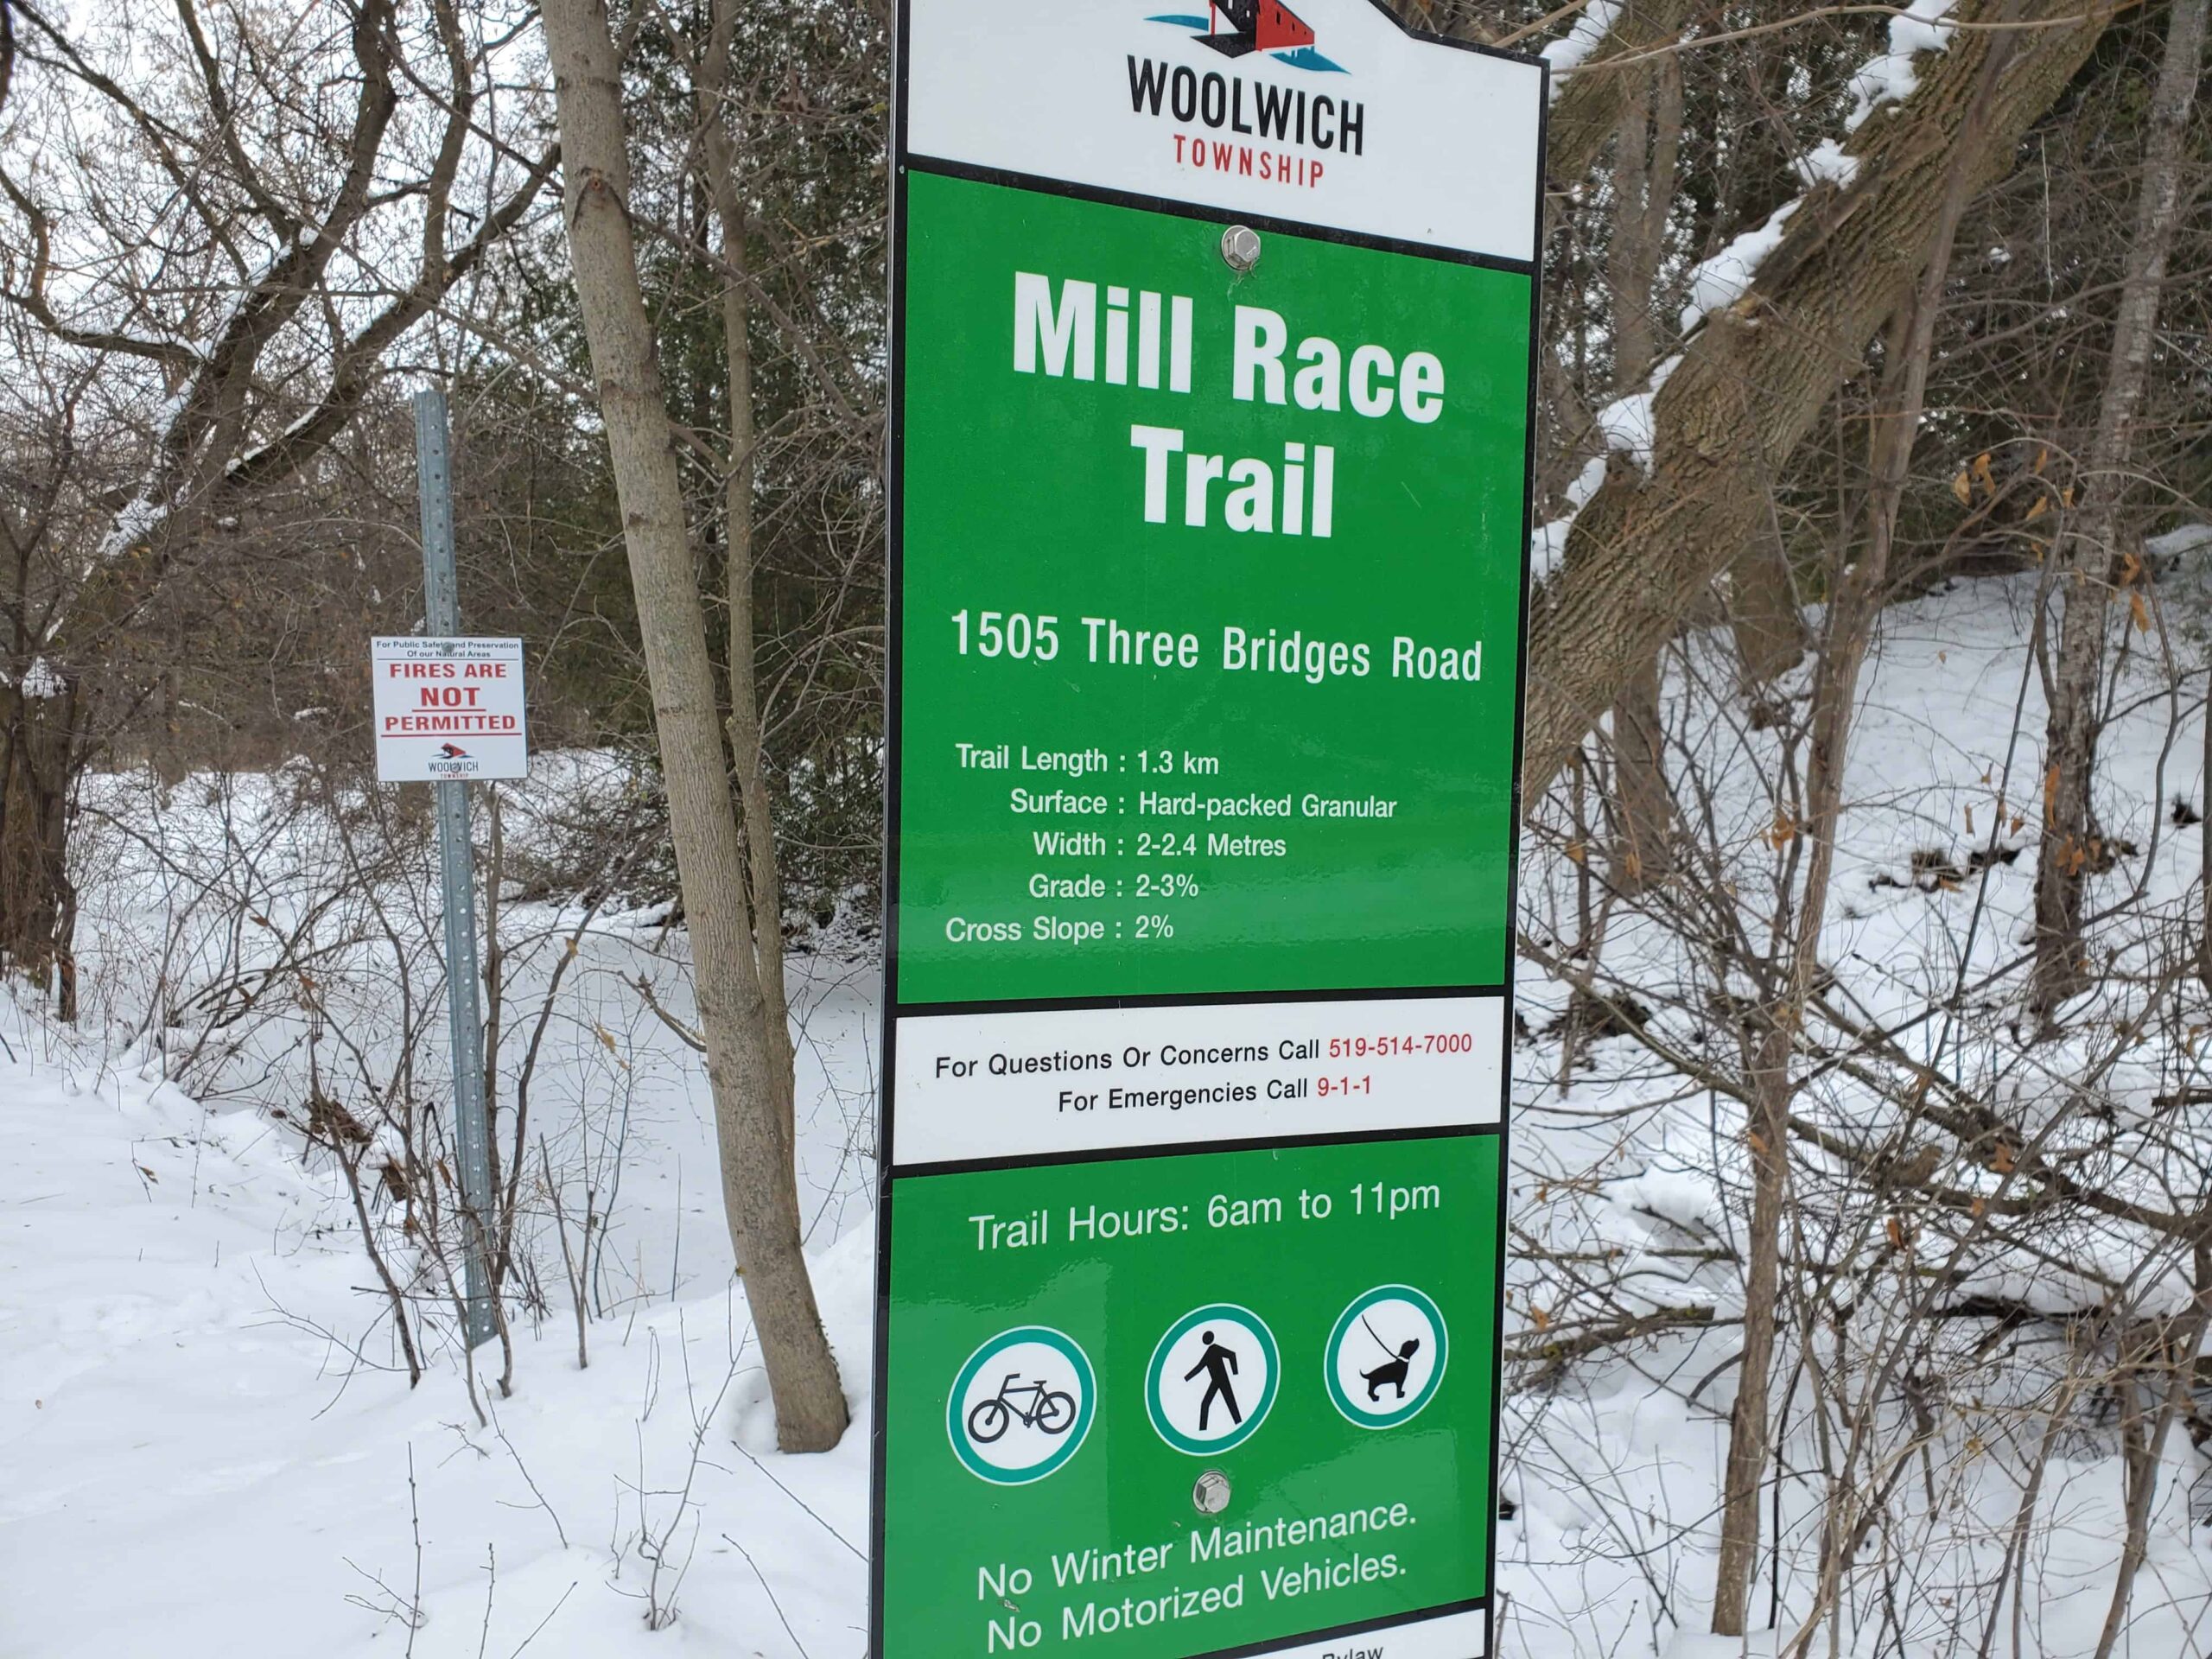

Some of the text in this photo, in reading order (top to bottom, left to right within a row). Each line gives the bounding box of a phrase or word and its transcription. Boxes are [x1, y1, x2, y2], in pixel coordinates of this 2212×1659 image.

[1127, 54, 1364, 156] WOOLWICH
[1174, 134, 1324, 188] TOWNSHIP
[1014, 271, 1445, 423] Mill Race
[1130, 424, 1335, 538] Trail
[376, 640, 391, 649] For
[393, 640, 420, 649] Public
[422, 640, 445, 649] Safet
[467, 640, 519, 650] Preservation
[467, 650, 491, 658] Areas
[951, 609, 1482, 684] 1505 Three Bridges Road
[390, 664, 507, 678] FIRES ARE
[421, 687, 480, 707] NOT
[385, 715, 516, 731] PERMITTED
[955, 743, 1219, 778] Trail Length : 1.3 km
[1010, 787, 1397, 821] Surface : Hard-packed Granular
[1033, 831, 1287, 856] Width : 2-2.4 Metres
[1028, 873, 1198, 899] Grade : 2-3%
[945, 914, 1174, 945] Cross Slope : 2%
[936, 1033, 1471, 1078] For Questions Or Concerns Call 519-514-7000
[1059, 1076, 1370, 1113] For Emergencies Call 9-1-1
[968, 1181, 1440, 1250] Trail Hours: 6am to 11pm
[978, 1501, 1416, 1601] No Winter Maintenance.
[988, 1554, 1406, 1654] No Motorized Vehicles.
[1322, 1647, 1383, 1659] law
